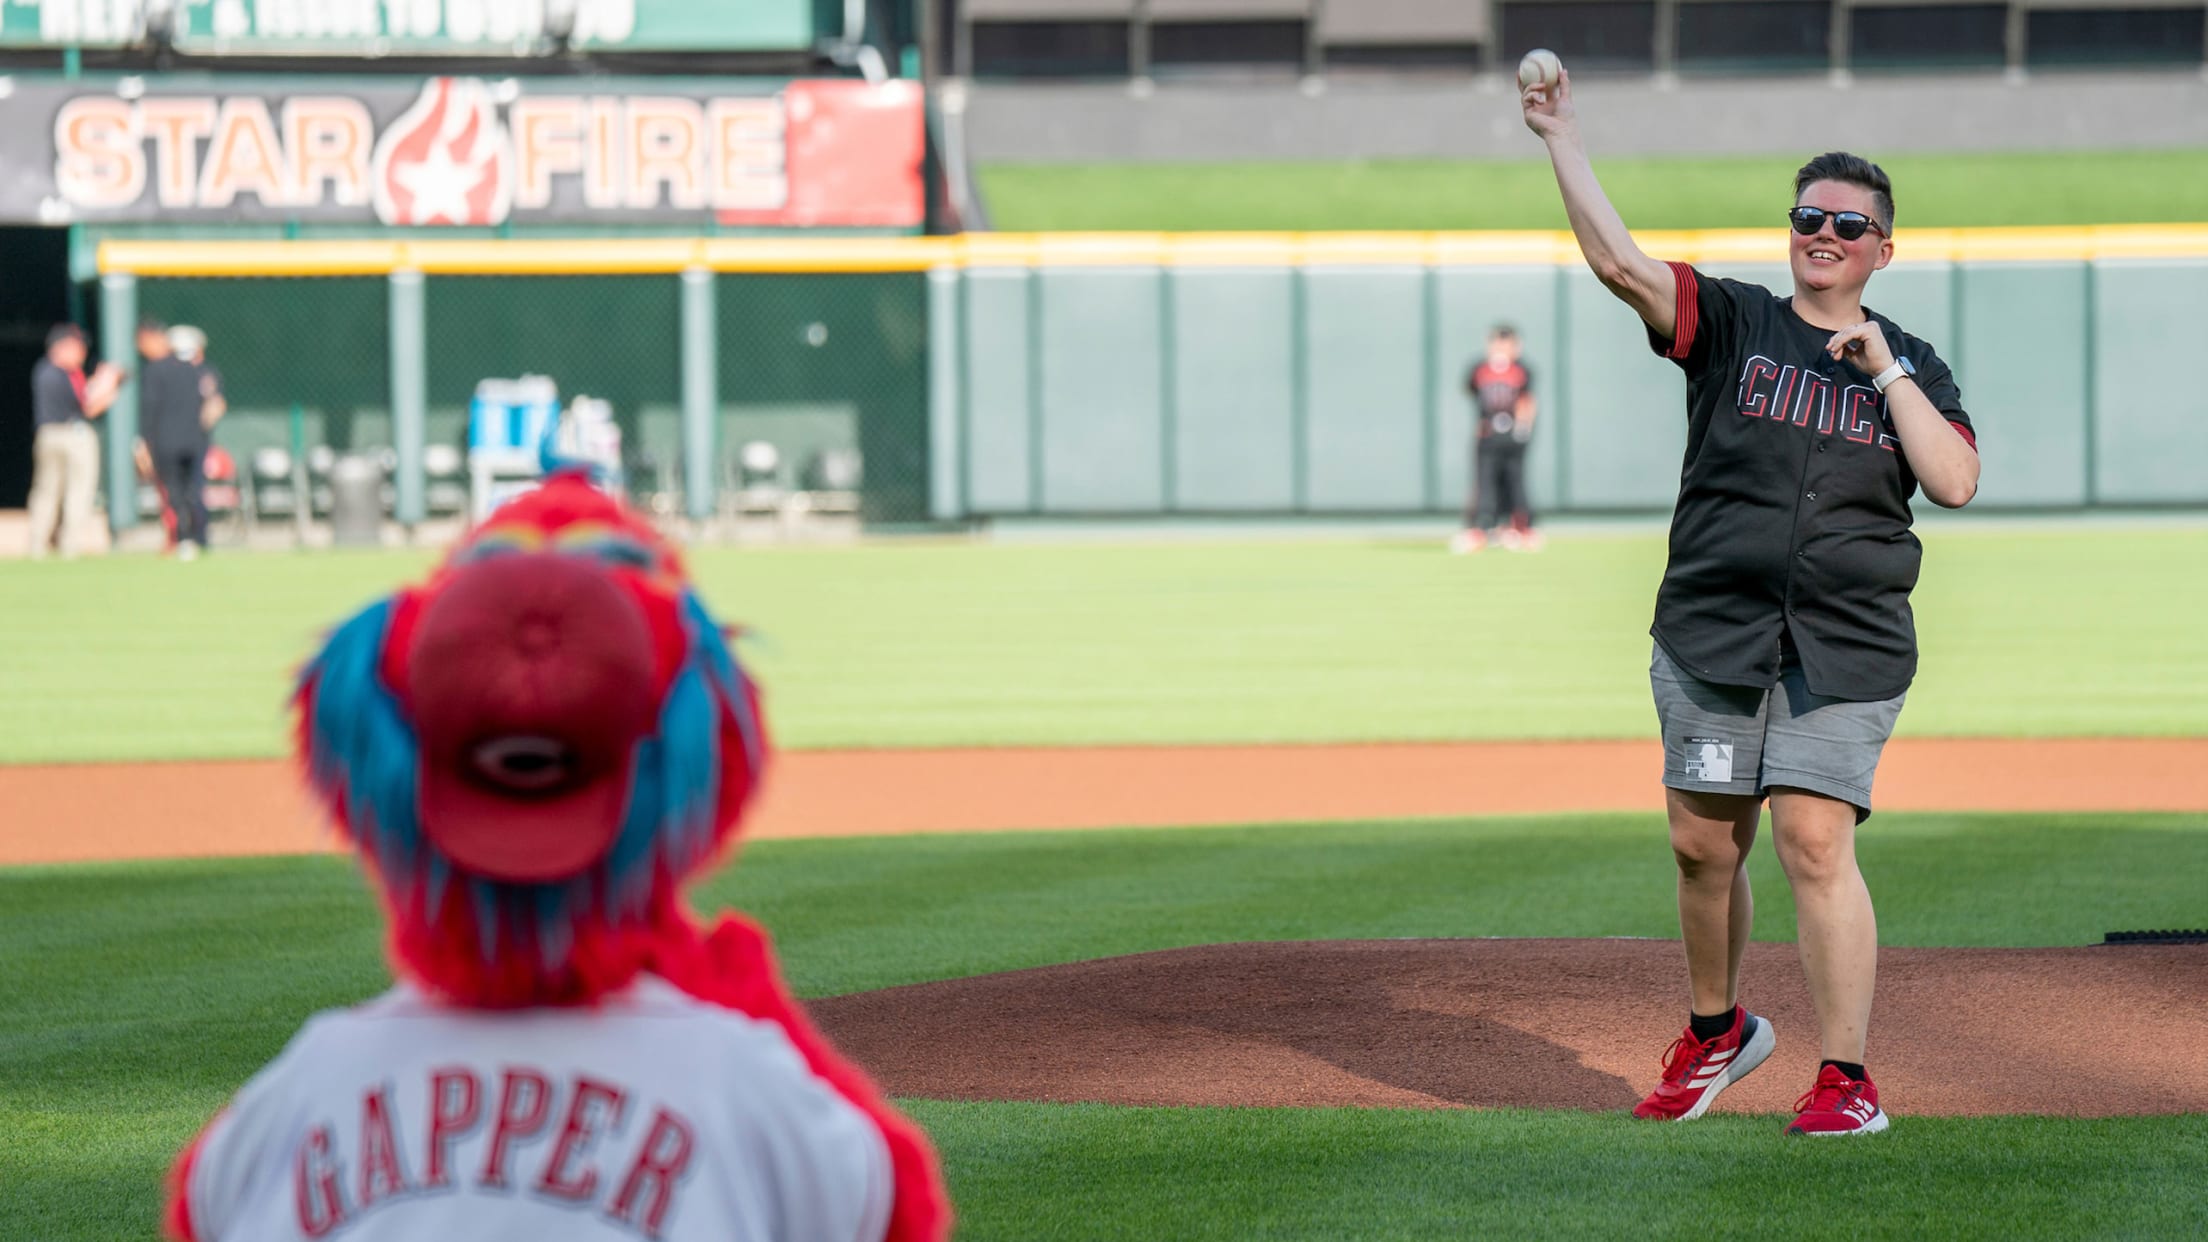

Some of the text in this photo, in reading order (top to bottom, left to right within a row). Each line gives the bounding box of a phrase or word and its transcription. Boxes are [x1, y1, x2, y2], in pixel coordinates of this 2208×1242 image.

[54, 95, 788, 210] STAR FIRE
[474, 735, 572, 790] C
[294, 1063, 698, 1241] GAPPER
